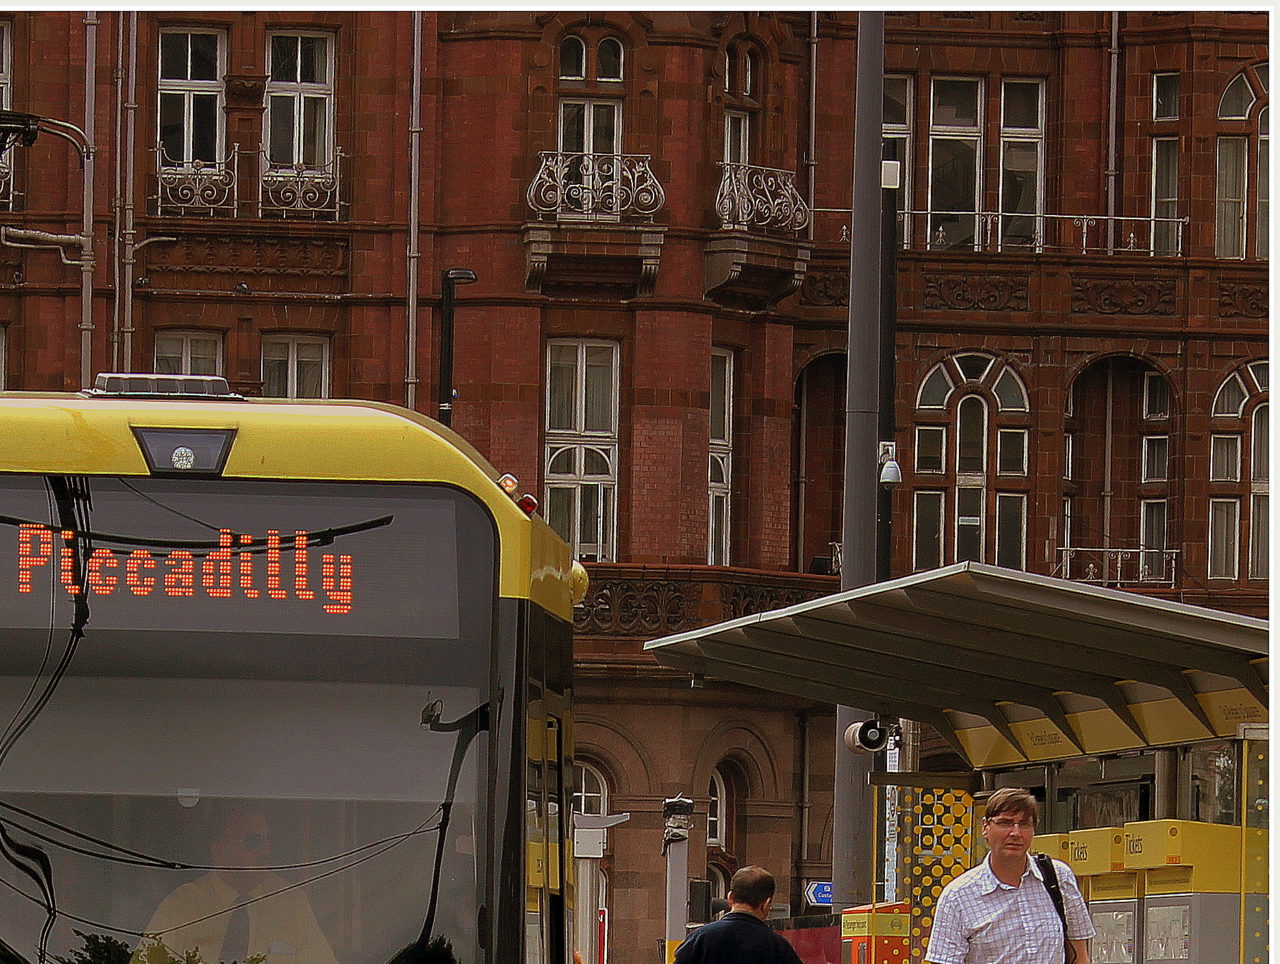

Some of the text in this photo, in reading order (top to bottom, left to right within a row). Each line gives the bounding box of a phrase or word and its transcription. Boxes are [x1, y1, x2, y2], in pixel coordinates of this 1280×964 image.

[18, 523, 352, 615] Piccadilly
[1070, 841, 1088, 862] Tickets
[1125, 834, 1143, 855] Tickets
